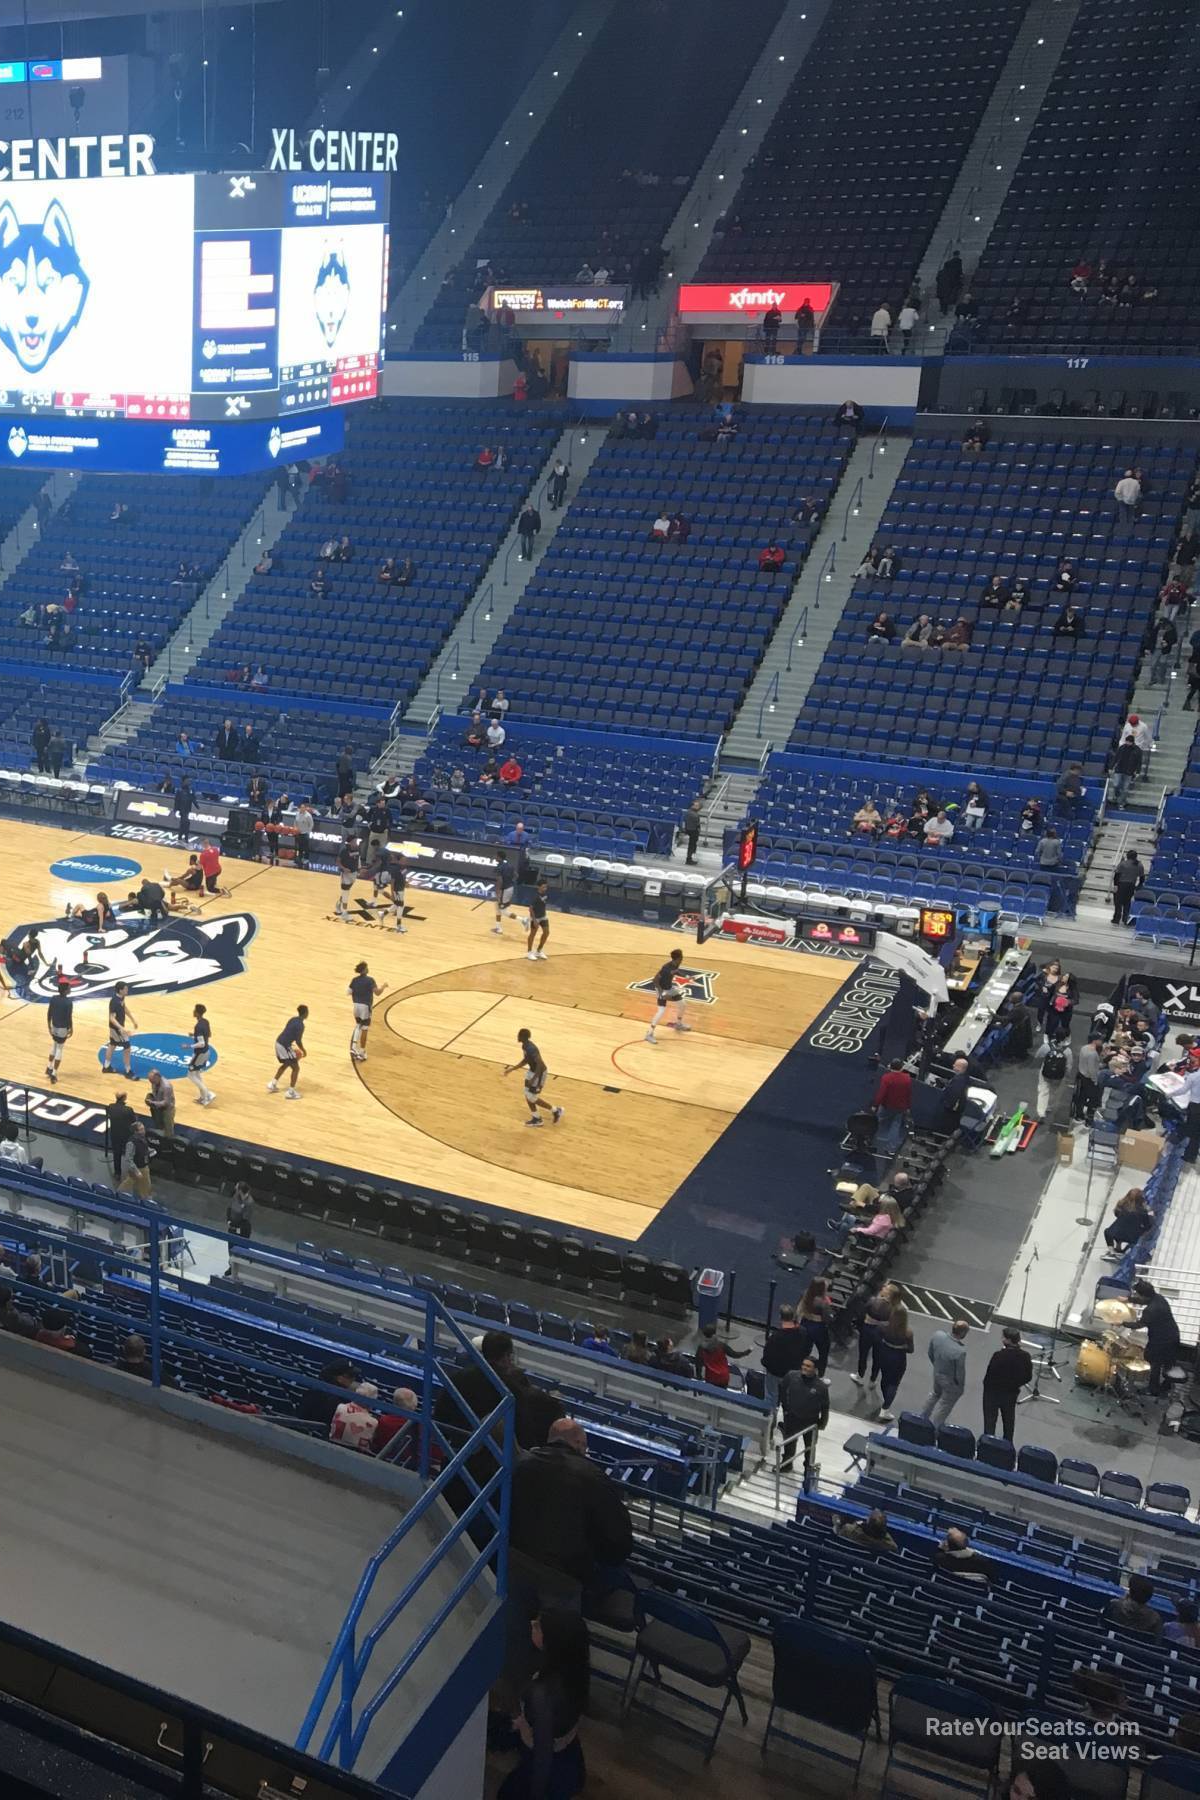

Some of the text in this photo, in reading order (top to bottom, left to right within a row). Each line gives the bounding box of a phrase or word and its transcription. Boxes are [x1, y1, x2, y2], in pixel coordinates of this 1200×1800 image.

[270, 128, 399, 172] XL CENTER
[729, 287, 786, 309] xfinity
[462, 352, 480, 362] 115
[764, 355, 785, 365] 116
[1066, 358, 1089, 369] 117
[225, 395, 252, 417] XL
[175, 810, 230, 826] CEVROLET
[931, 922, 947, 936] 30
[1162, 983, 1200, 1011] XL
[809, 963, 901, 1054] HUSKIES
[1172, 1010, 1200, 1020] CENTE
